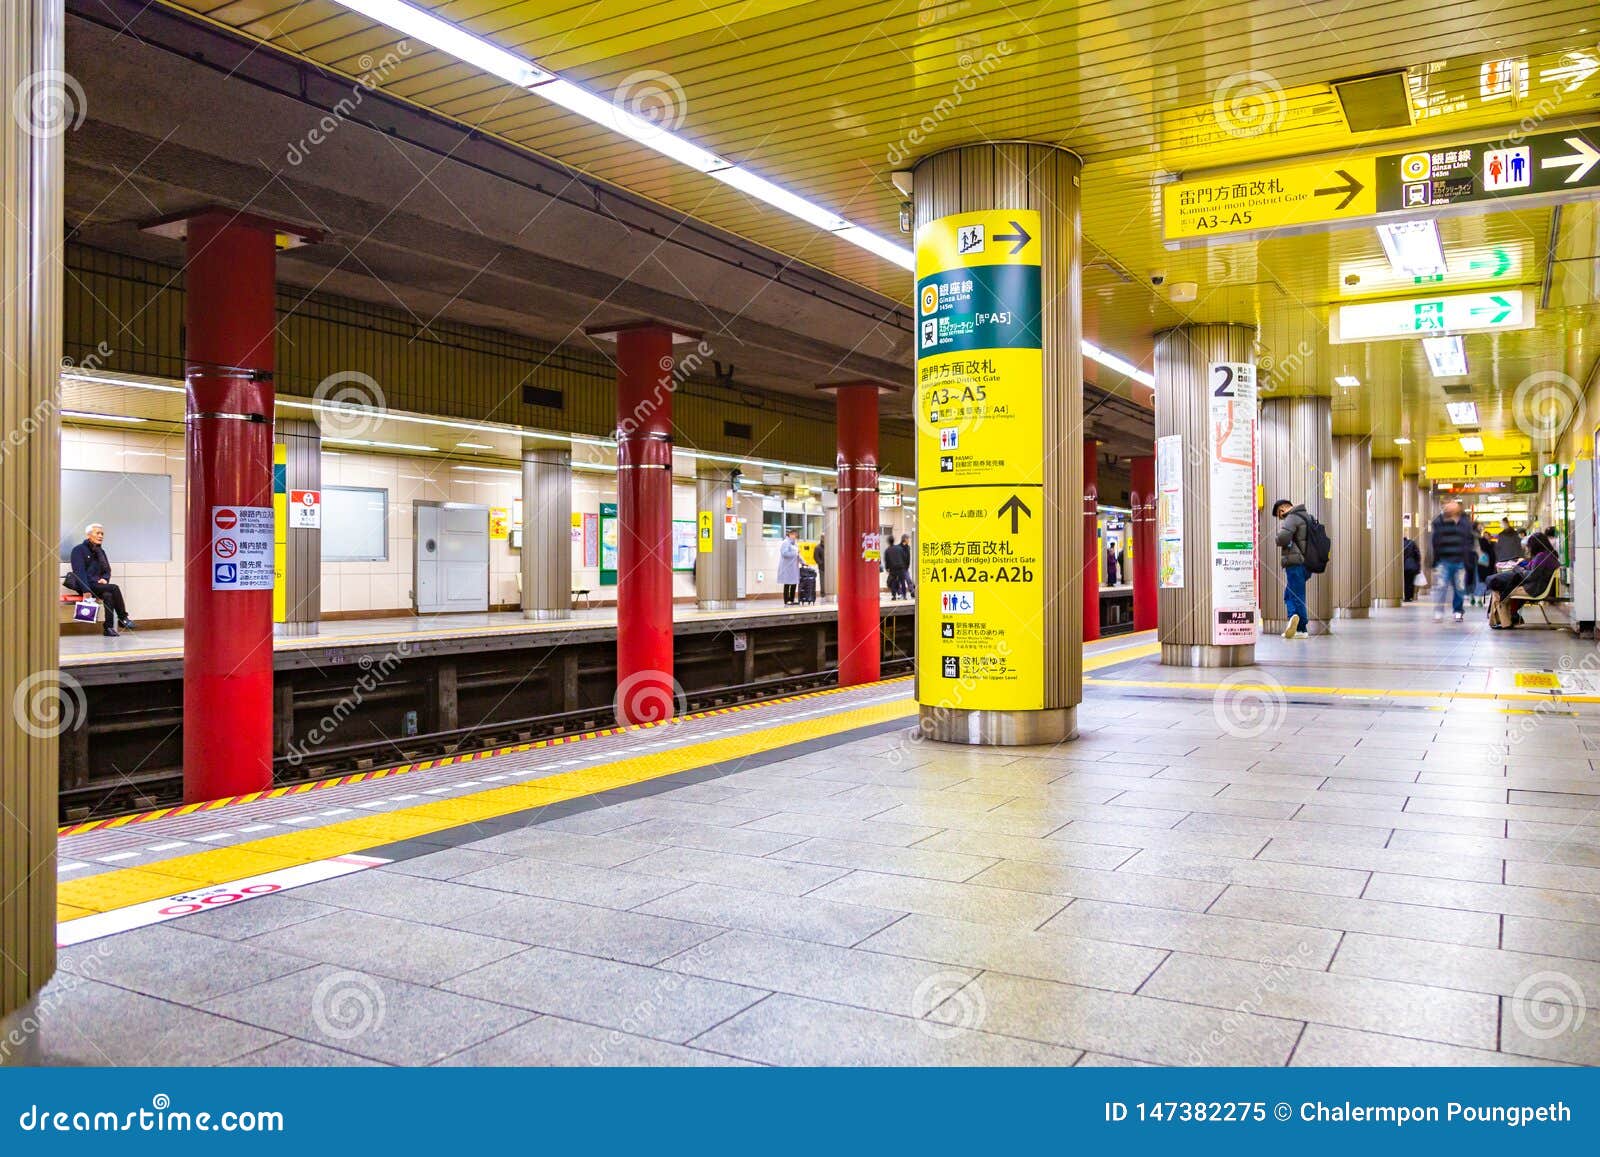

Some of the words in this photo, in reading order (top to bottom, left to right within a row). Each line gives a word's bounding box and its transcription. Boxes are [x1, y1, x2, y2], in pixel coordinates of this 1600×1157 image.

[1180, 178, 1284, 206] 雷門方面改札
[1248, 196, 1282, 208] District
[1284, 192, 1308, 203] Gate
[956, 293, 971, 301] Line
[921, 359, 996, 382] 雷門方面改札
[1214, 365, 1235, 397] 2
[922, 540, 1014, 557] 駒形橋方面改札
[962, 557, 991, 566] (Bridge)
[992, 556, 1018, 564] District
[962, 666, 1017, 674] エレベーター
